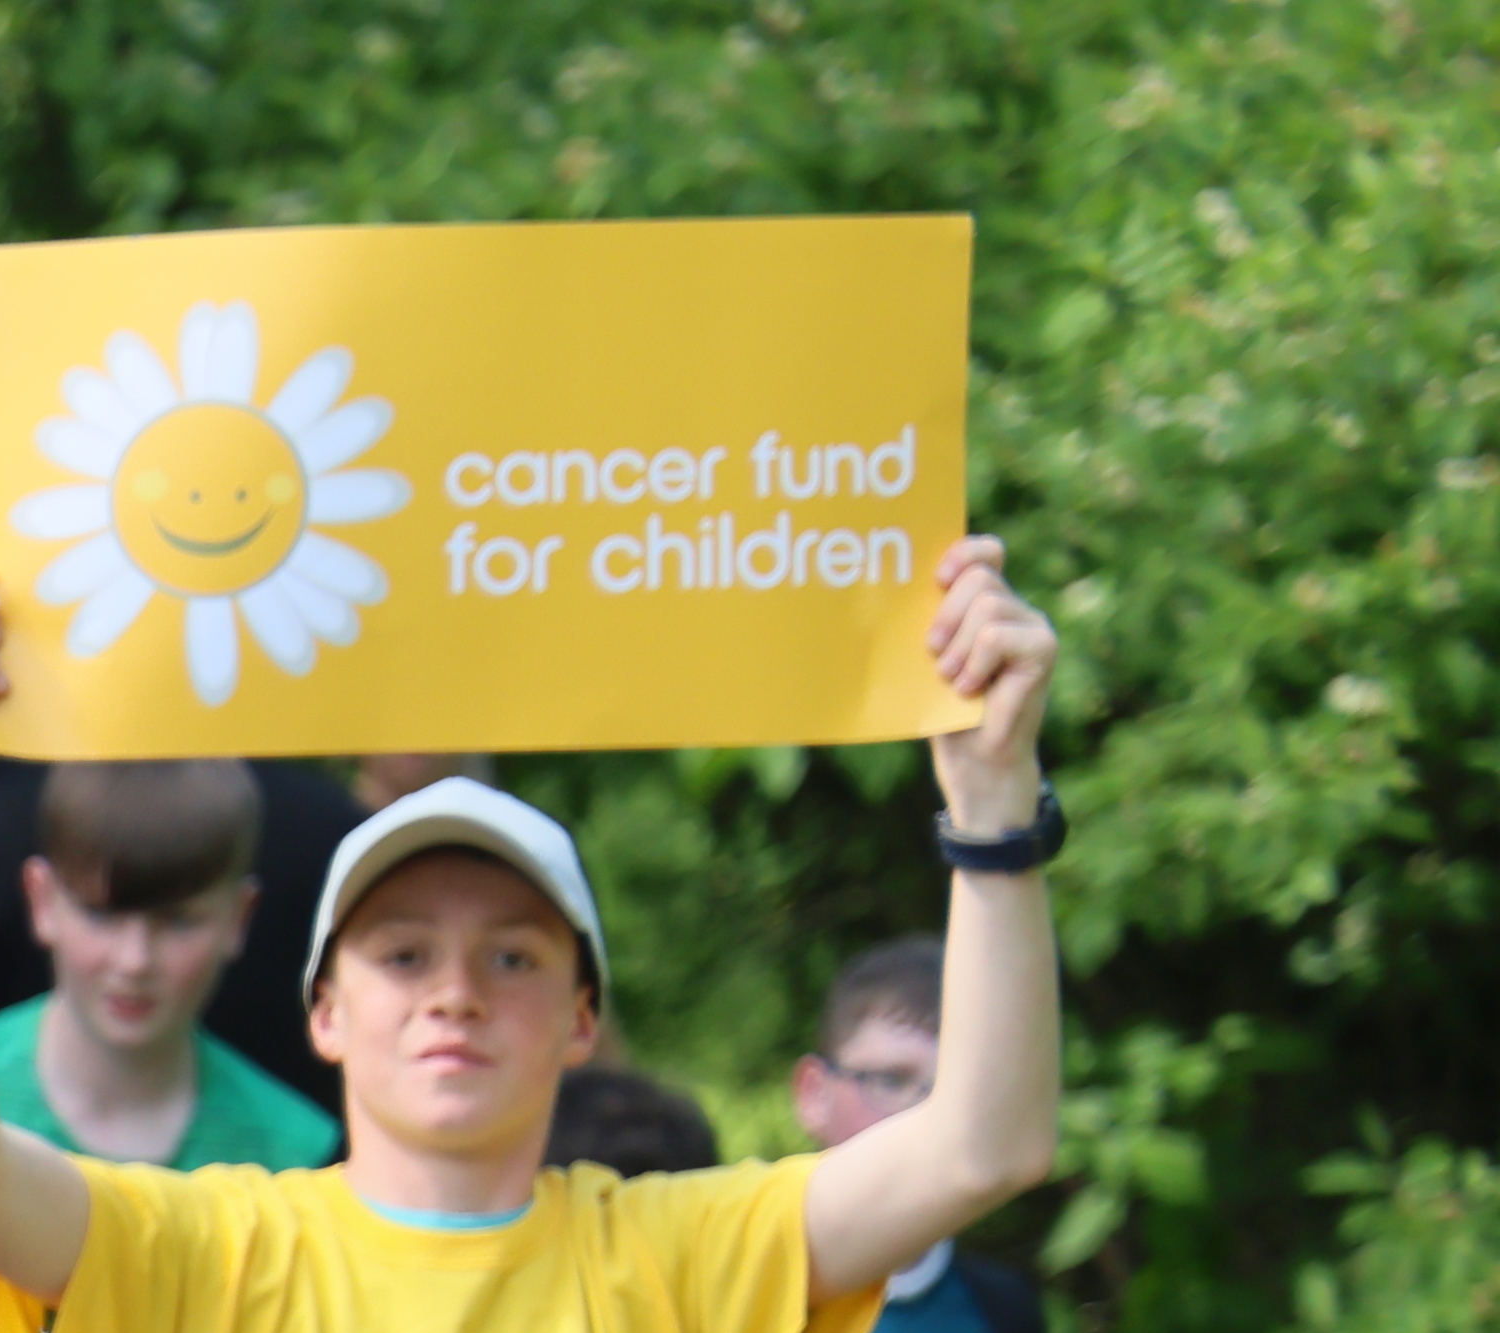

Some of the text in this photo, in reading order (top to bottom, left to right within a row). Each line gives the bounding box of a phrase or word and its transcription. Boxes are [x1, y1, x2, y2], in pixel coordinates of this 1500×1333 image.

[444, 424, 917, 507] cancer fund
[446, 512, 912, 596] for children
